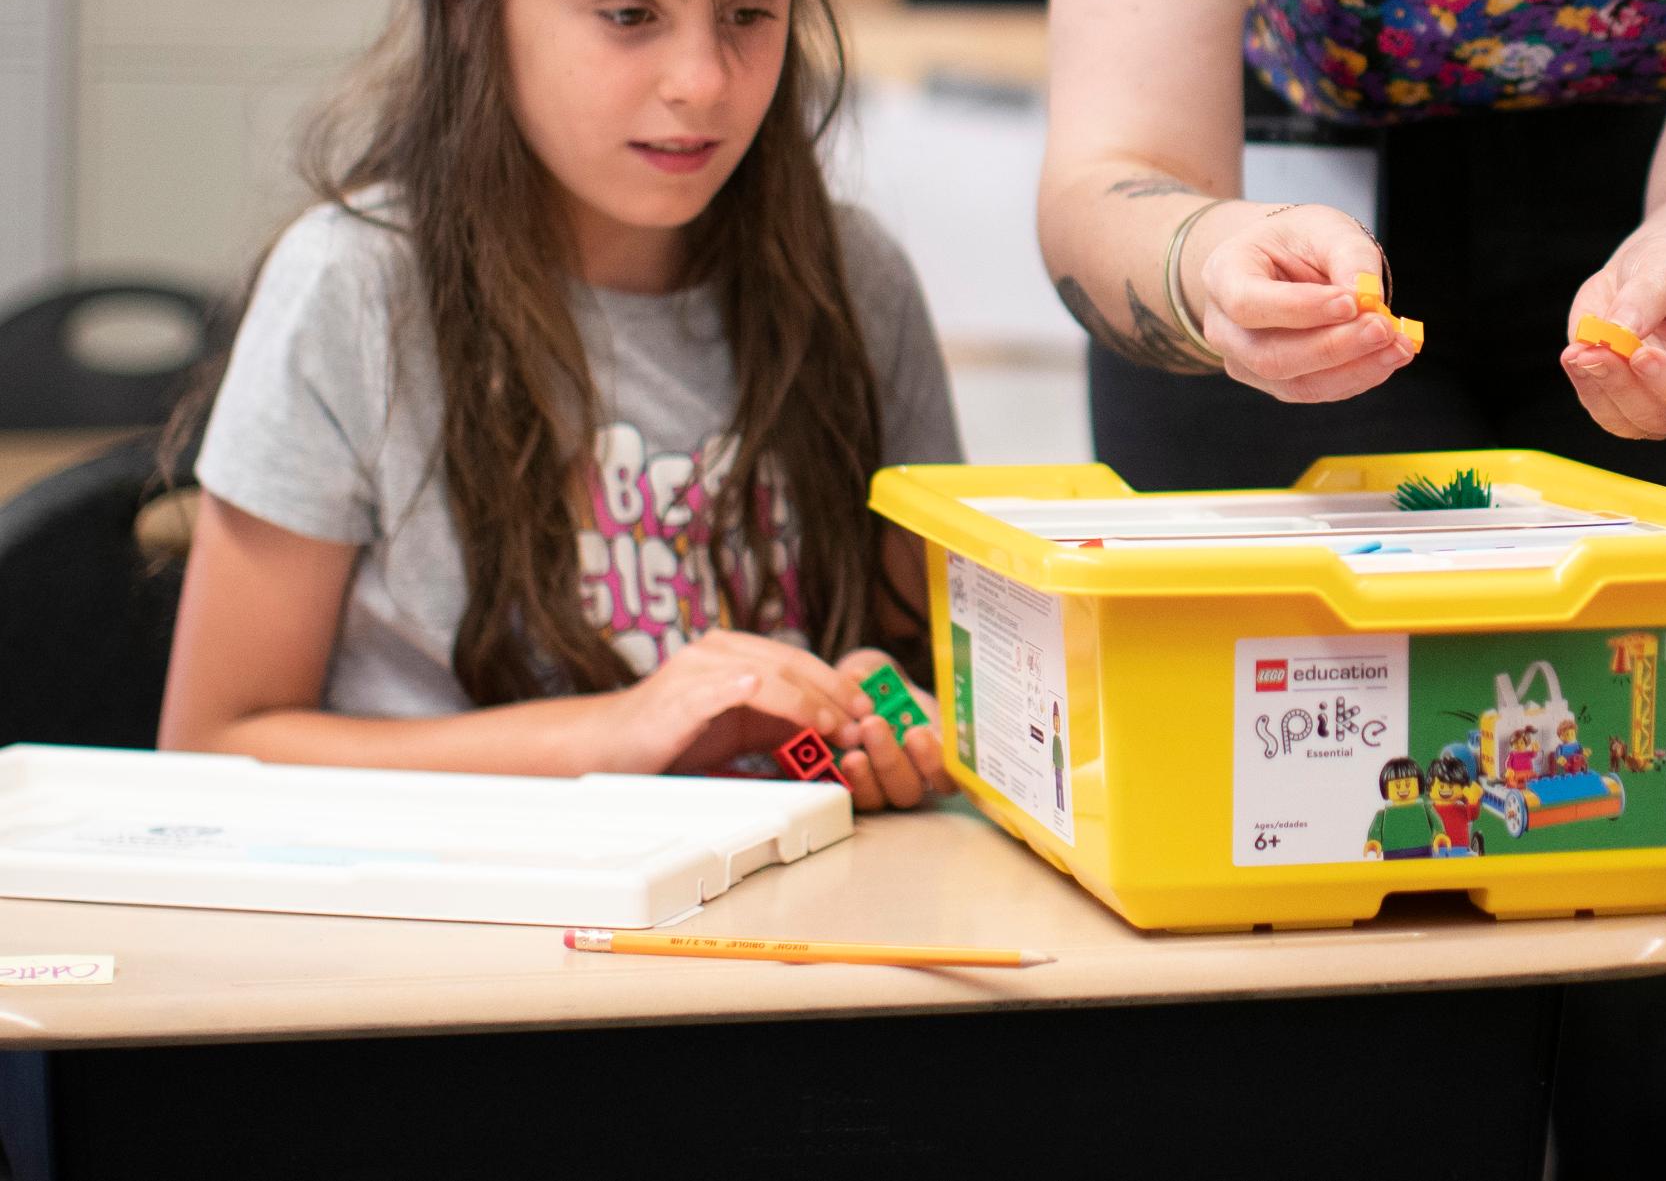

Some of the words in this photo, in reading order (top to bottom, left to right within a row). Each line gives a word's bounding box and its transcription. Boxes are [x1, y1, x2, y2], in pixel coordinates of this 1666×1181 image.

[1257, 668, 1286, 684] LEGO
[1293, 663, 1389, 681] education
[1306, 748, 1354, 758] Essential
[1254, 820, 1308, 830] Ages/edades
[1254, 832, 1281, 851] 6+
